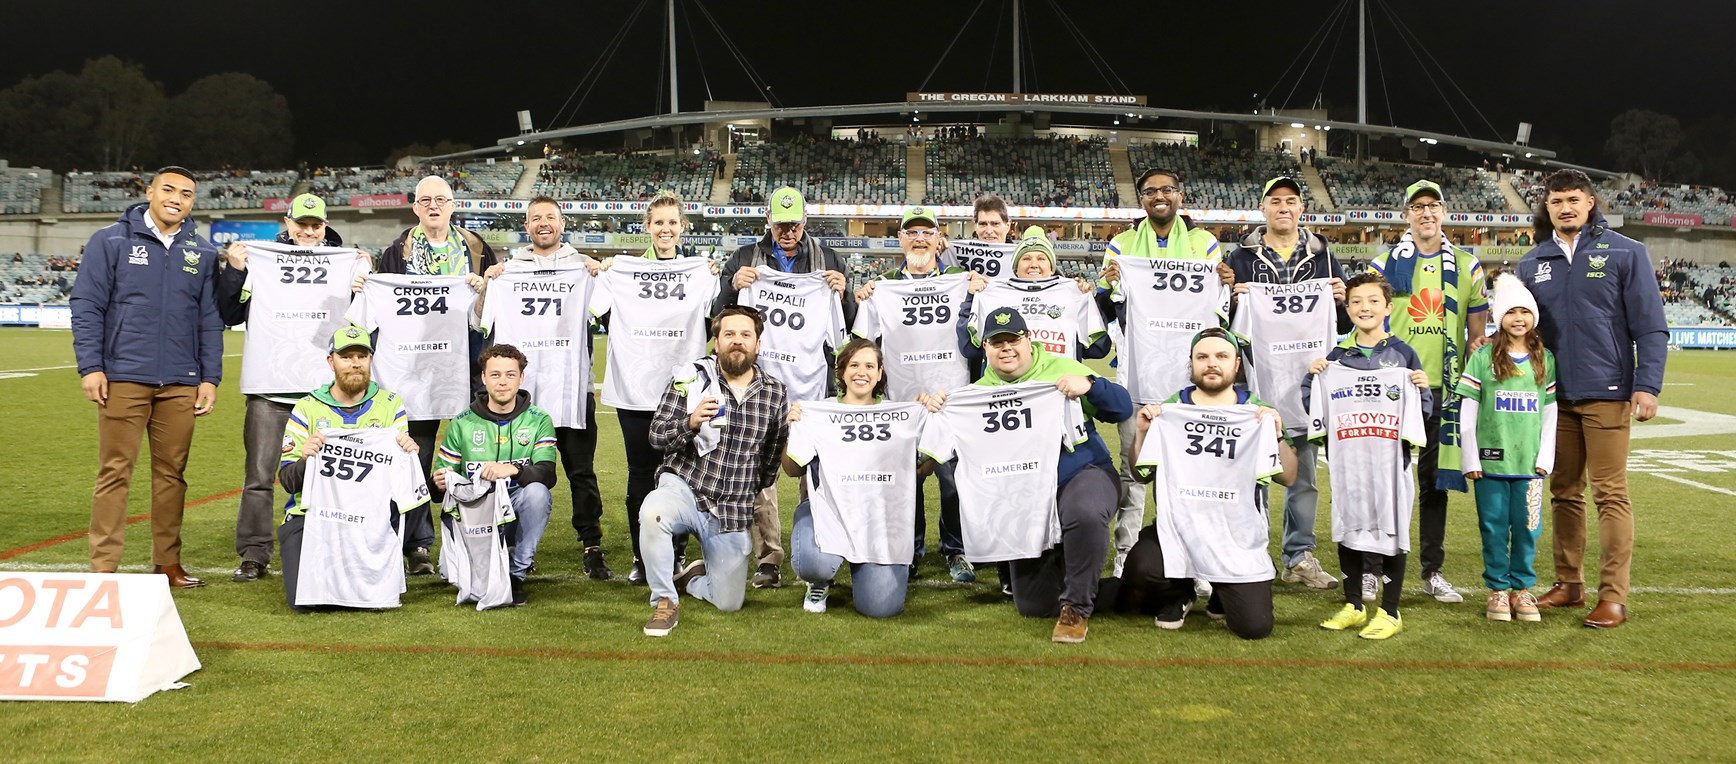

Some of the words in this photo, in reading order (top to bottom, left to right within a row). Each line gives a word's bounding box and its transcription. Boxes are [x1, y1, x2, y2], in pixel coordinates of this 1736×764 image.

[918, 93, 944, 101] THE
[1024, 94, 1088, 102] LARKHAM
[1094, 96, 1137, 104] STAND
[358, 196, 401, 206] allhomes
[1651, 214, 1695, 226] allhomes
[826, 239, 863, 247] TOGETHER
[954, 246, 1004, 258] TIMOKO
[276, 254, 331, 265] RAPANA
[1149, 259, 1213, 273] WIGHTON
[280, 266, 328, 284] 322
[633, 272, 692, 282] FOGARTY
[513, 282, 576, 293] FRAWLEY
[774, 280, 796, 289] RAIDERS
[1152, 272, 1204, 294] 303
[1264, 283, 1323, 295] MARIOTA
[393, 286, 450, 296] CROKER
[638, 281, 686, 300] 384
[759, 290, 806, 308] PAPALII
[902, 294, 950, 306] YOUNG
[1272, 294, 1320, 314] 387
[396, 296, 449, 316] 284
[521, 297, 562, 316] 371
[1021, 304, 1046, 315] 362
[755, 304, 805, 331] 300
[902, 305, 951, 326] 359
[1150, 320, 1202, 330] PALMERBET
[633, 329, 684, 338] PALMERBET
[1676, 331, 1695, 345] LIVE
[398, 343, 448, 352] PALMERBET
[522, 339, 570, 349] PALMERBET
[1272, 341, 1323, 352] PALMERBET
[903, 352, 952, 362] PALMERBET
[1331, 390, 1353, 400] MILK
[1355, 384, 1381, 397] 353
[988, 398, 1023, 410] KRIS
[1496, 397, 1538, 412] MILK
[829, 411, 910, 424] WOOLFORD
[982, 408, 1032, 433] 361
[1201, 414, 1228, 422] RAIDERS
[841, 423, 892, 442] 383
[1184, 422, 1242, 438] COTRIC
[1185, 434, 1236, 460] 341
[319, 443, 393, 466] RSBURGH
[320, 455, 374, 483] 357
[985, 461, 1039, 475] PALMERBET
[841, 474, 892, 482] PALMERBET
[1180, 488, 1236, 500] PALMERBET
[502, 504, 511, 517] 2
[0, 578, 123, 628] OTA
